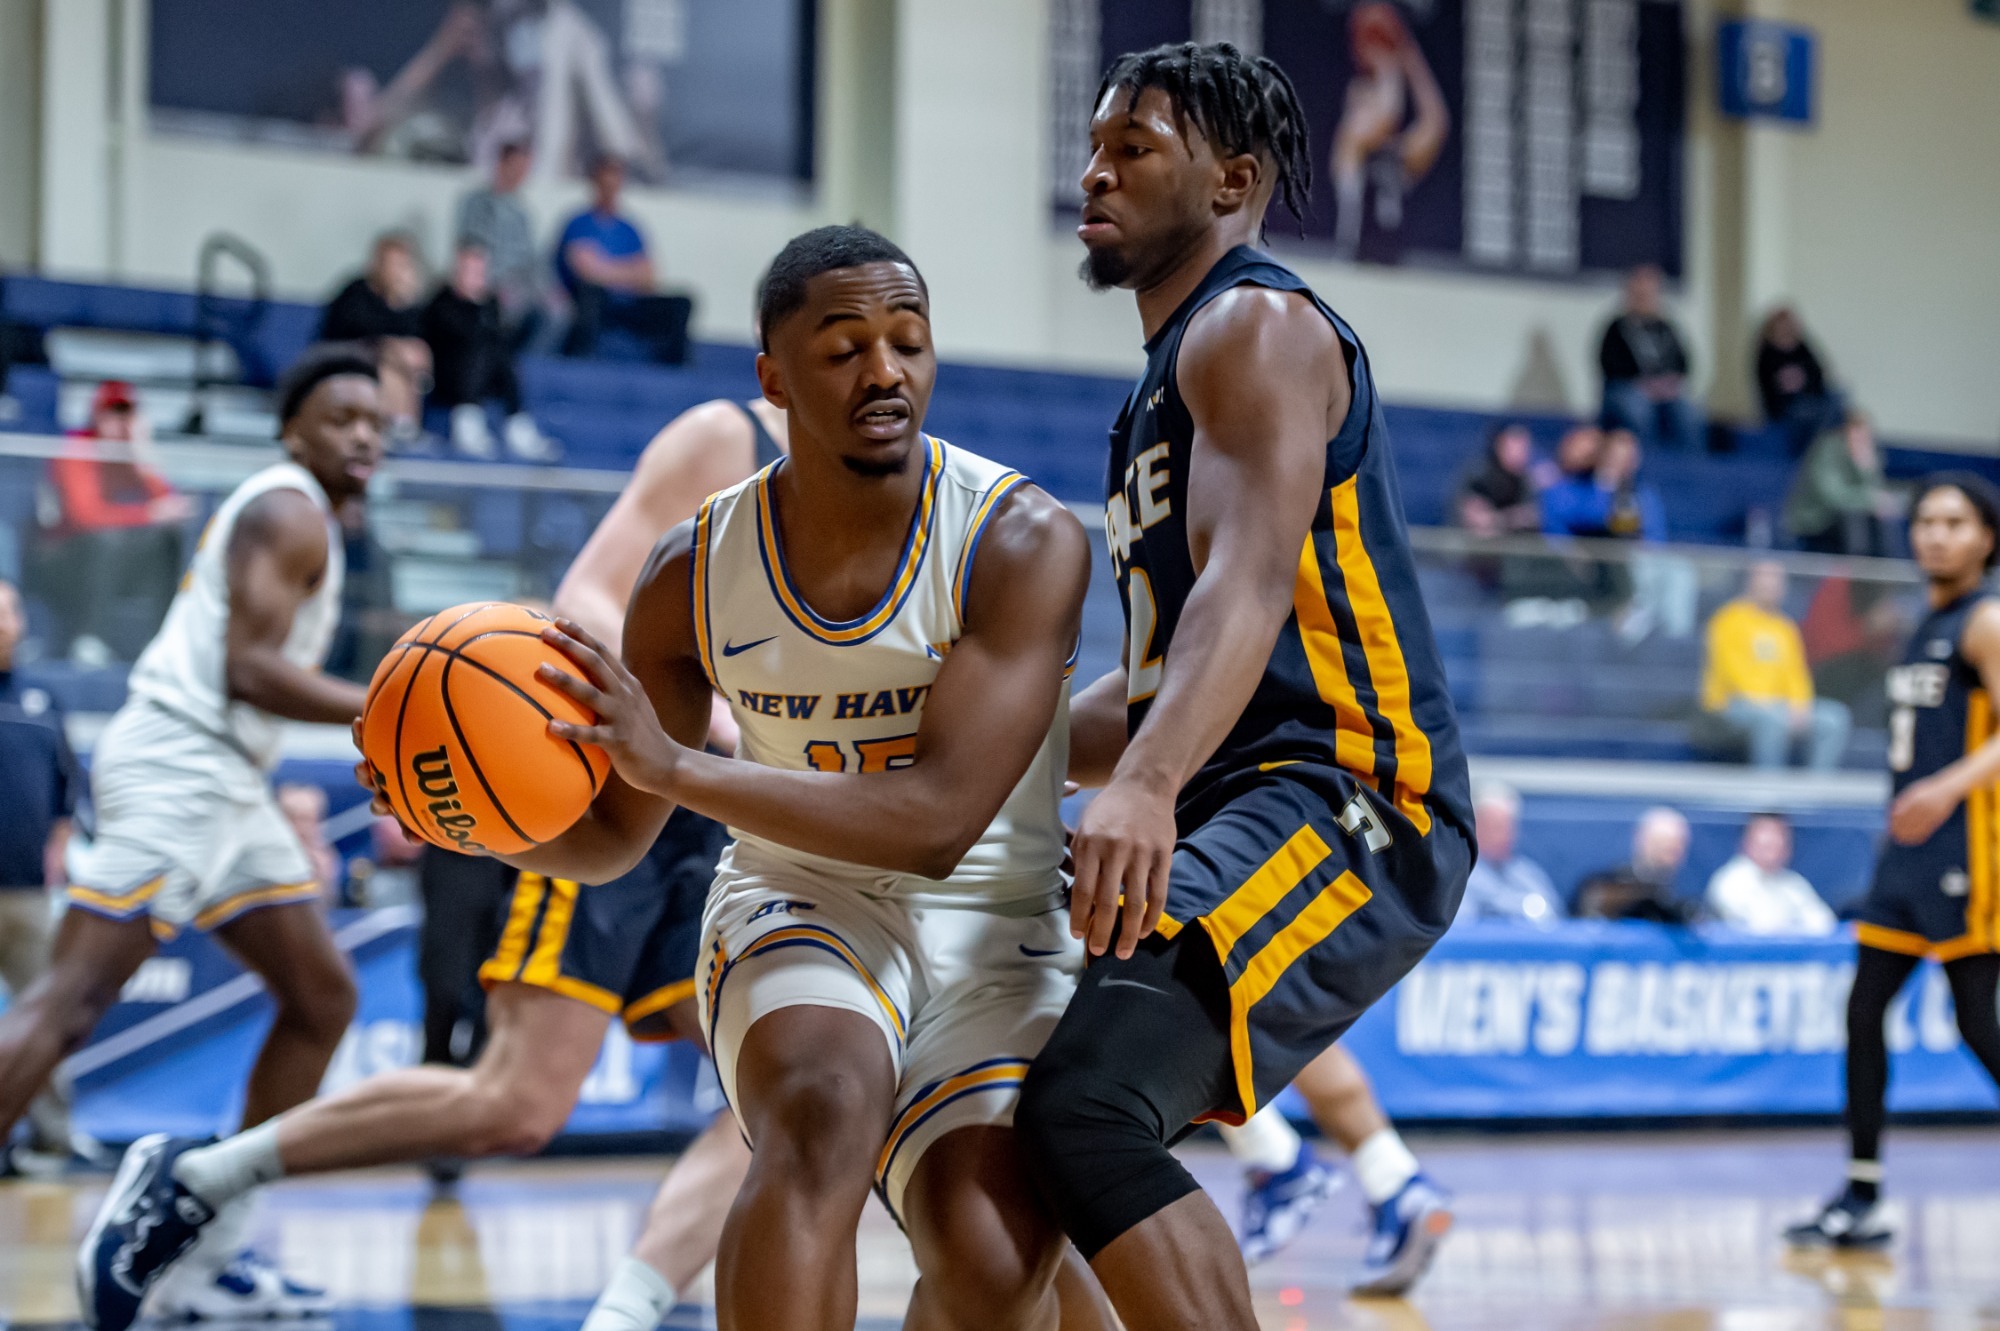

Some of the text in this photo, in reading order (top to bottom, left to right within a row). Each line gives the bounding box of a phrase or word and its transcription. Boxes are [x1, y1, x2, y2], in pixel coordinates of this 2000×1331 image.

[737, 684, 933, 720] NEW HAV
[411, 744, 488, 853] Wilso
[1396, 962, 1586, 1055] MEN'S
